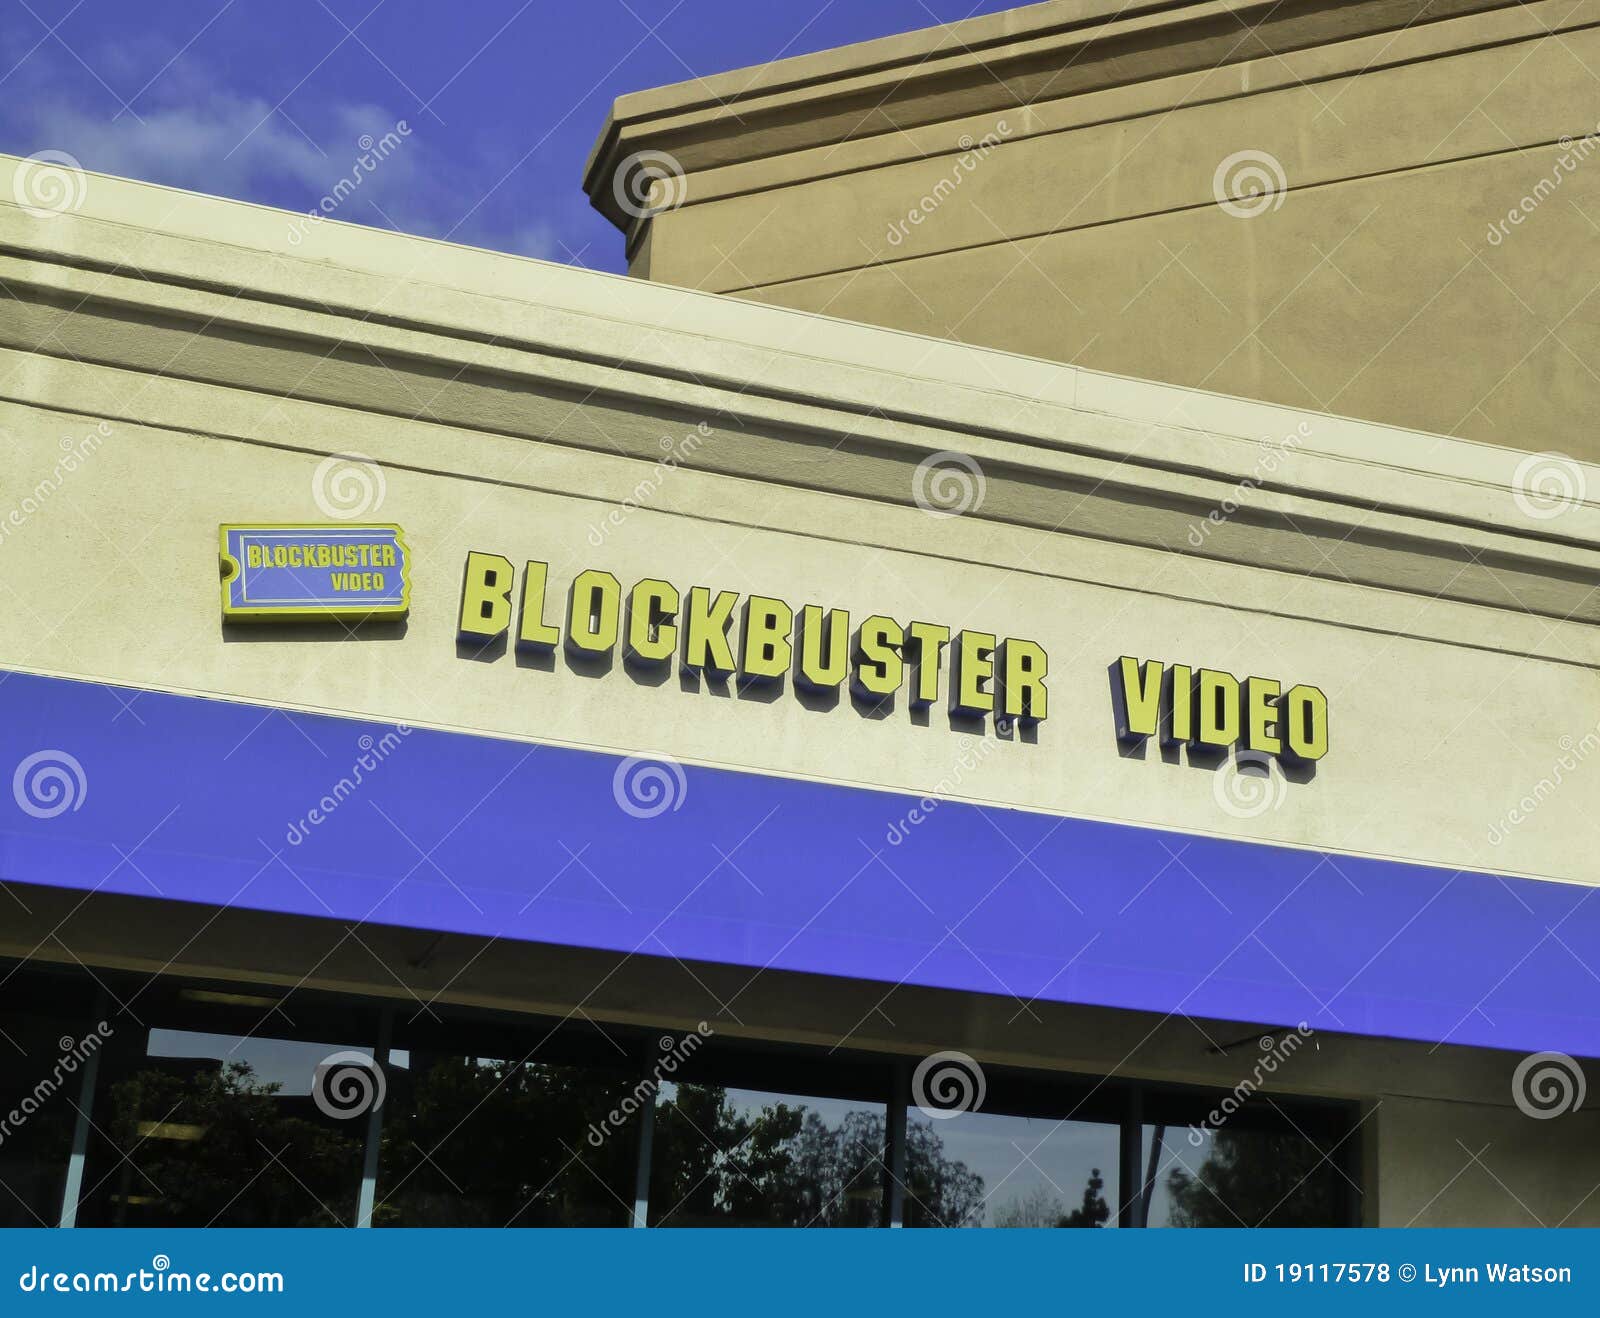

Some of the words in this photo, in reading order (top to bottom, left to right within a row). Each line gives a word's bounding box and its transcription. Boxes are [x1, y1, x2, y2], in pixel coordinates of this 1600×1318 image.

[248, 543, 397, 568] BLOCKBUSTER
[331, 572, 385, 592] VIDEO
[459, 550, 1048, 721] BLOCKBUSTER
[1114, 655, 1329, 762] VIDEO
